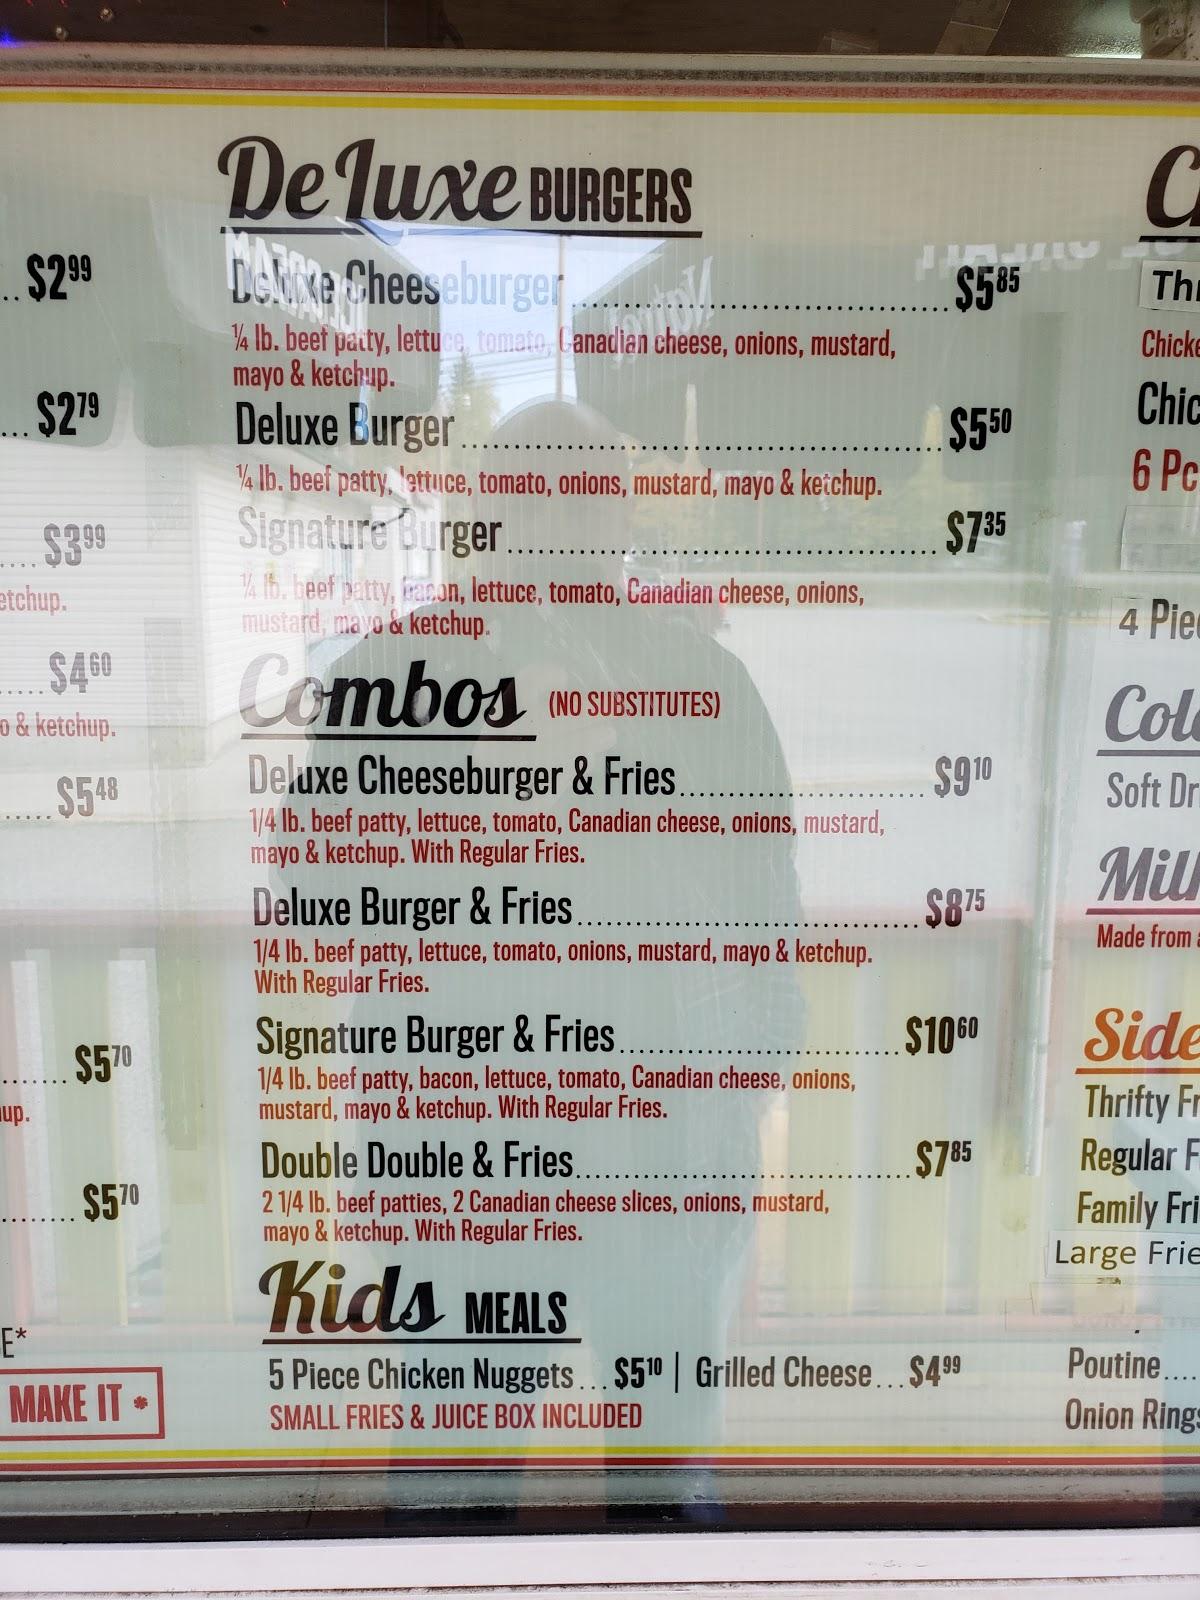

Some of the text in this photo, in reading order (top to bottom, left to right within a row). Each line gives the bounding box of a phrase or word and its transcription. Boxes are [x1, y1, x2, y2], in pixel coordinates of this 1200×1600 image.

[531, 167, 692, 224] BURGERS
[232, 258, 335, 304] Deluxe
[346, 258, 563, 313] Cheeseburger
[285, 323, 896, 360] beef patty, Canadian cheese, onions, mustard,
[234, 359, 395, 392] mayo ketchup.
[236, 402, 338, 446] Deluxe
[349, 402, 454, 453] Burger
[290, 464, 331, 491] beef
[338, 470, 393, 497] patty,
[479, 472, 552, 497] tomato,
[559, 471, 627, 498] onions,
[634, 468, 717, 497] mustard,
[725, 476, 774, 500] mayo
[801, 468, 882, 500] ketchup.
[1133, 448, 1151, 491] 6
[238, 506, 388, 556] Signature
[400, 508, 503, 558] Burger
[471, 574, 864, 607] lettuce, tomato, Canadian cheese, onions,
[410, 609, 490, 640] ketchup.
[1119, 608, 1138, 635] 4
[239, 653, 720, 728] Combos (NO SUBSTITUTES)
[36, 712, 115, 741] ketchup.
[249, 754, 348, 795] Deluxe
[358, 755, 563, 801] Cheeseburger
[573, 756, 593, 795] &
[605, 756, 675, 795] Fries
[1107, 772, 1161, 808] Soft
[312, 808, 883, 837] beef patty, lettuce, tomato, Canadian cheese, onions, mustard,
[252, 839, 585, 868] mayo ketchup. With Regular Fries.
[254, 887, 350, 926] Deluxe
[361, 887, 460, 931] Burger
[470, 886, 491, 924] &
[503, 886, 572, 924] Fries
[315, 938, 872, 967] beef patty, lettuce, tomato, onions, mustard, mayo ketchup.
[1097, 924, 1191, 948] Made from
[255, 969, 429, 997] With Regular Fries.
[257, 1016, 396, 1060] Signature
[407, 1015, 504, 1059] Burger
[514, 1014, 534, 1052] &
[546, 1014, 614, 1052] Fries
[317, 1065, 855, 1094] beef patty, bacon, lettuce, tomato, Canadian cheese, onions,
[260, 1095, 667, 1124] mustard, mayo ketchup. With Regular Fries.
[1085, 1084, 1170, 1124] Thrifty
[262, 1142, 357, 1178] Double
[368, 1141, 463, 1178] Double
[473, 1141, 493, 1178] &
[505, 1141, 573, 1177] Fries
[1081, 1138, 1177, 1176] Regular
[337, 1189, 829, 1217] beef patties, Canadian cheese slices, onions, mustard,
[1078, 1191, 1158, 1230] Family
[264, 1218, 582, 1245] mayo ketchup. With Regular Fries.
[1056, 1240, 1136, 1270] Large
[258, 1260, 567, 1334] Kids MEALS
[270, 1359, 283, 1390] 5
[293, 1359, 359, 1389] Piece
[368, 1358, 464, 1389] Chicken
[474, 1358, 573, 1393] Nuggets
[696, 1356, 775, 1387] Grilled
[784, 1356, 871, 1387] Cheese
[1069, 1347, 1160, 1379] Poutine
[10, 1384, 122, 1423] MAKE IT
[271, 1403, 642, 1430] SMALL FRIES & JUICE BOX INCLUDED
[1065, 1398, 1133, 1429] Onion
